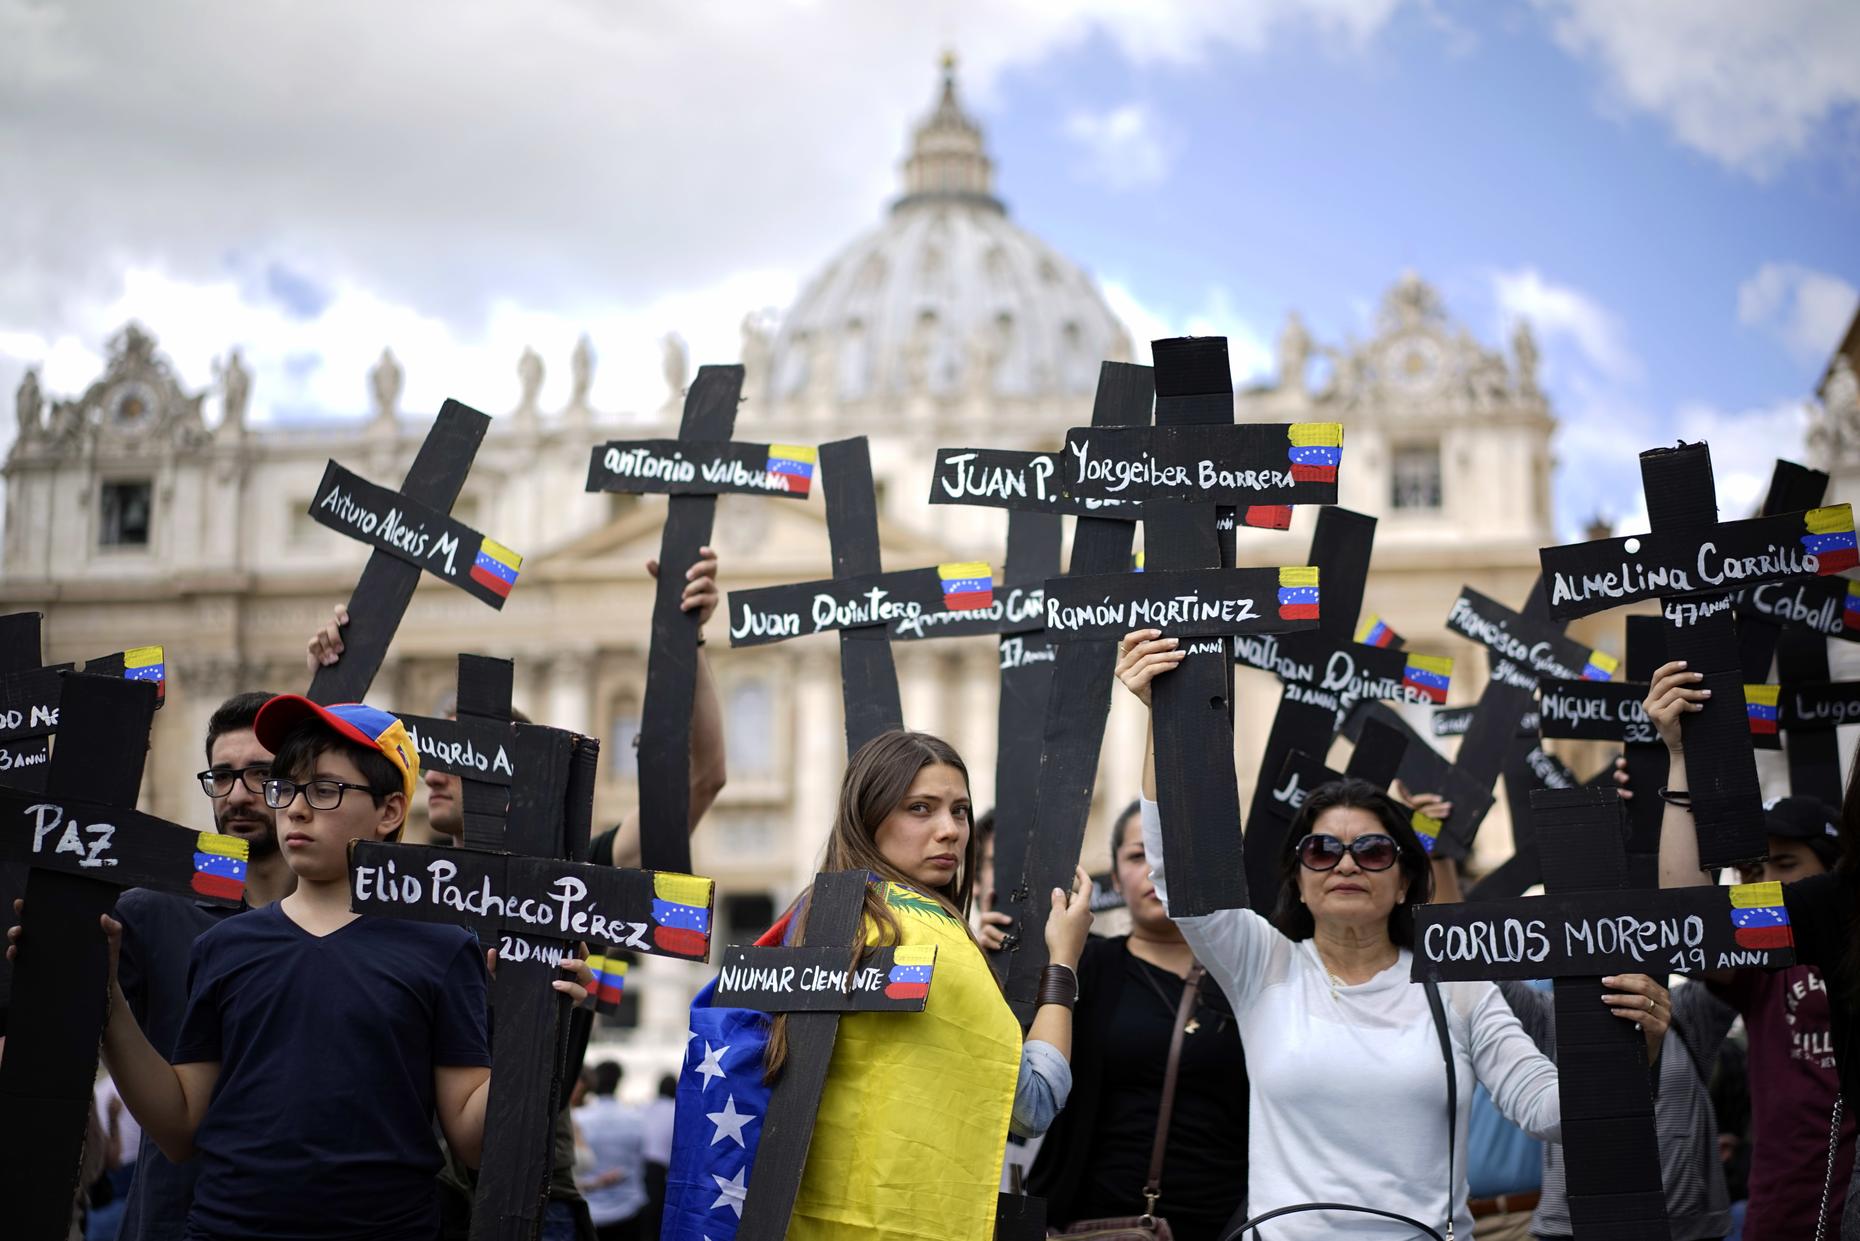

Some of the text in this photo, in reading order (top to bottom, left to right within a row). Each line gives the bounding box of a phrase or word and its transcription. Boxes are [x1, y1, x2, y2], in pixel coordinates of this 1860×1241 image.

[941, 453, 1028, 500] JUAN
[321, 485, 459, 576] Arturo Alexis M.
[731, 604, 800, 638] Juan
[1665, 602, 1698, 628] 47
[1000, 637, 1023, 670] 17
[427, 859, 555, 926] Pacheco
[499, 936, 531, 962] 20
[1669, 948, 1769, 973] 19 ANNI
